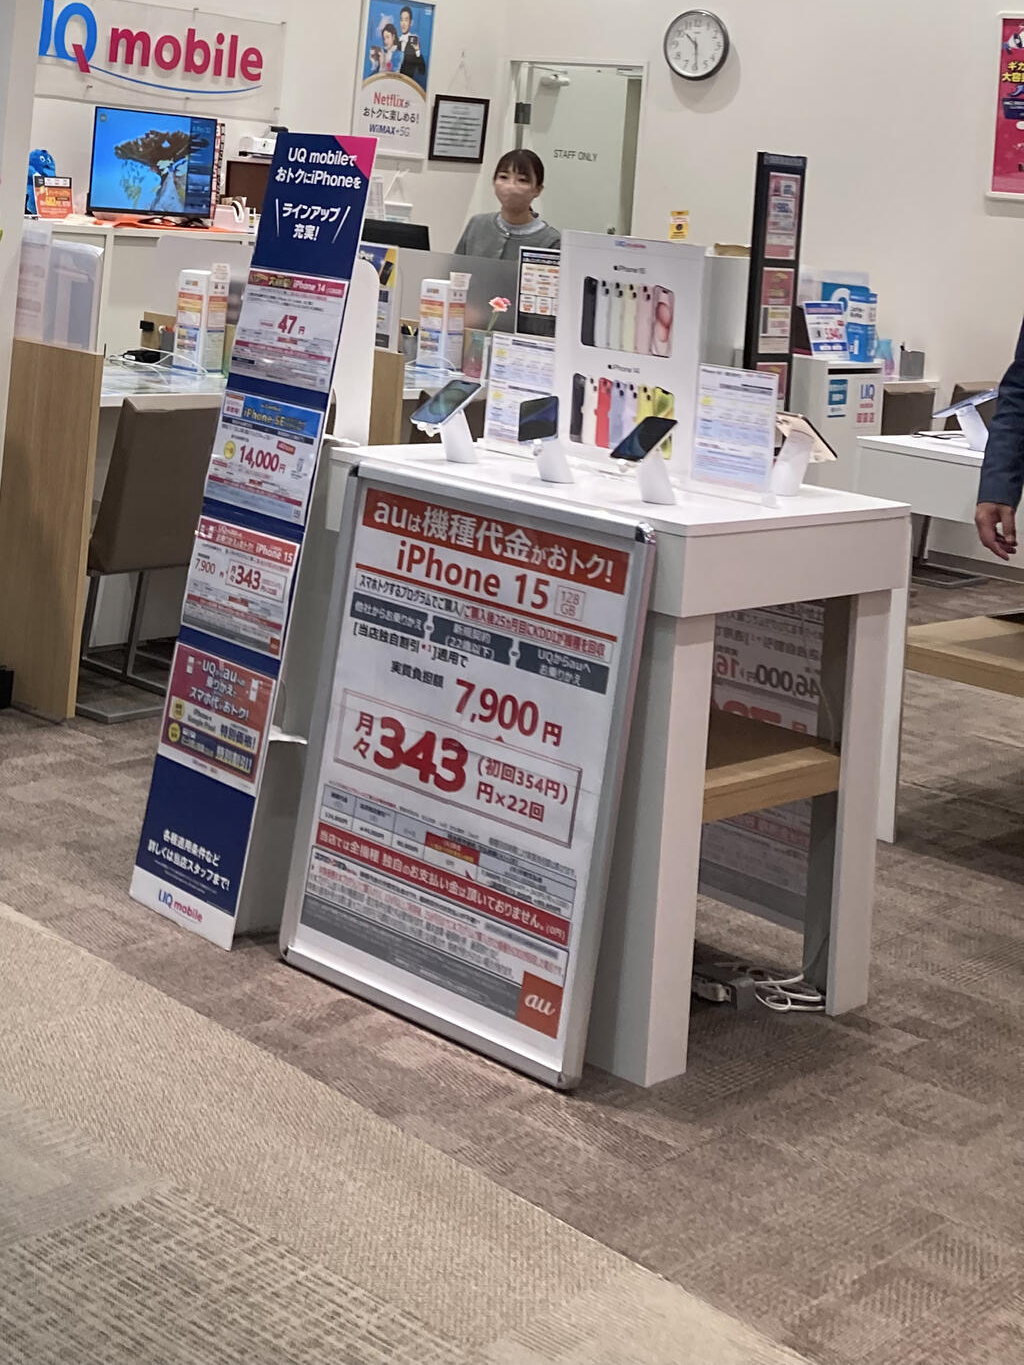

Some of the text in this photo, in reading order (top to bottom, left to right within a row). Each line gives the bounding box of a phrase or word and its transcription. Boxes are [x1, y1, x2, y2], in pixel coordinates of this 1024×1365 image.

[108, 27, 264, 82] mobile
[363, 106, 420, 124] おトクに楽しめる!
[288, 147, 358, 167] UQ mobileで
[553, 148, 599, 163] STAFF ONLY
[275, 166, 362, 190] おトクにiPhoneを
[282, 203, 341, 222] ラインアップ
[293, 223, 320, 242] 充実!
[293, 279, 327, 293] iPhone 14
[278, 314, 298, 334] 47
[860, 384, 875, 401] UQ
[243, 407, 273, 424] iPhone
[373, 500, 615, 584] auは機種代金がおトク!
[256, 543, 293, 563] iPhone 15
[235, 565, 262, 591] 343
[396, 539, 551, 610] iPhone 15
[560, 590, 581, 606] 128
[560, 602, 577, 618] GB
[391, 660, 444, 689] 実質負担額
[455, 677, 563, 747] 7,900 円
[373, 716, 469, 793] 343
[477, 756, 569, 806] (初回354円)
[158, 889, 203, 923] UQ mobile
[524, 993, 556, 1017] au
